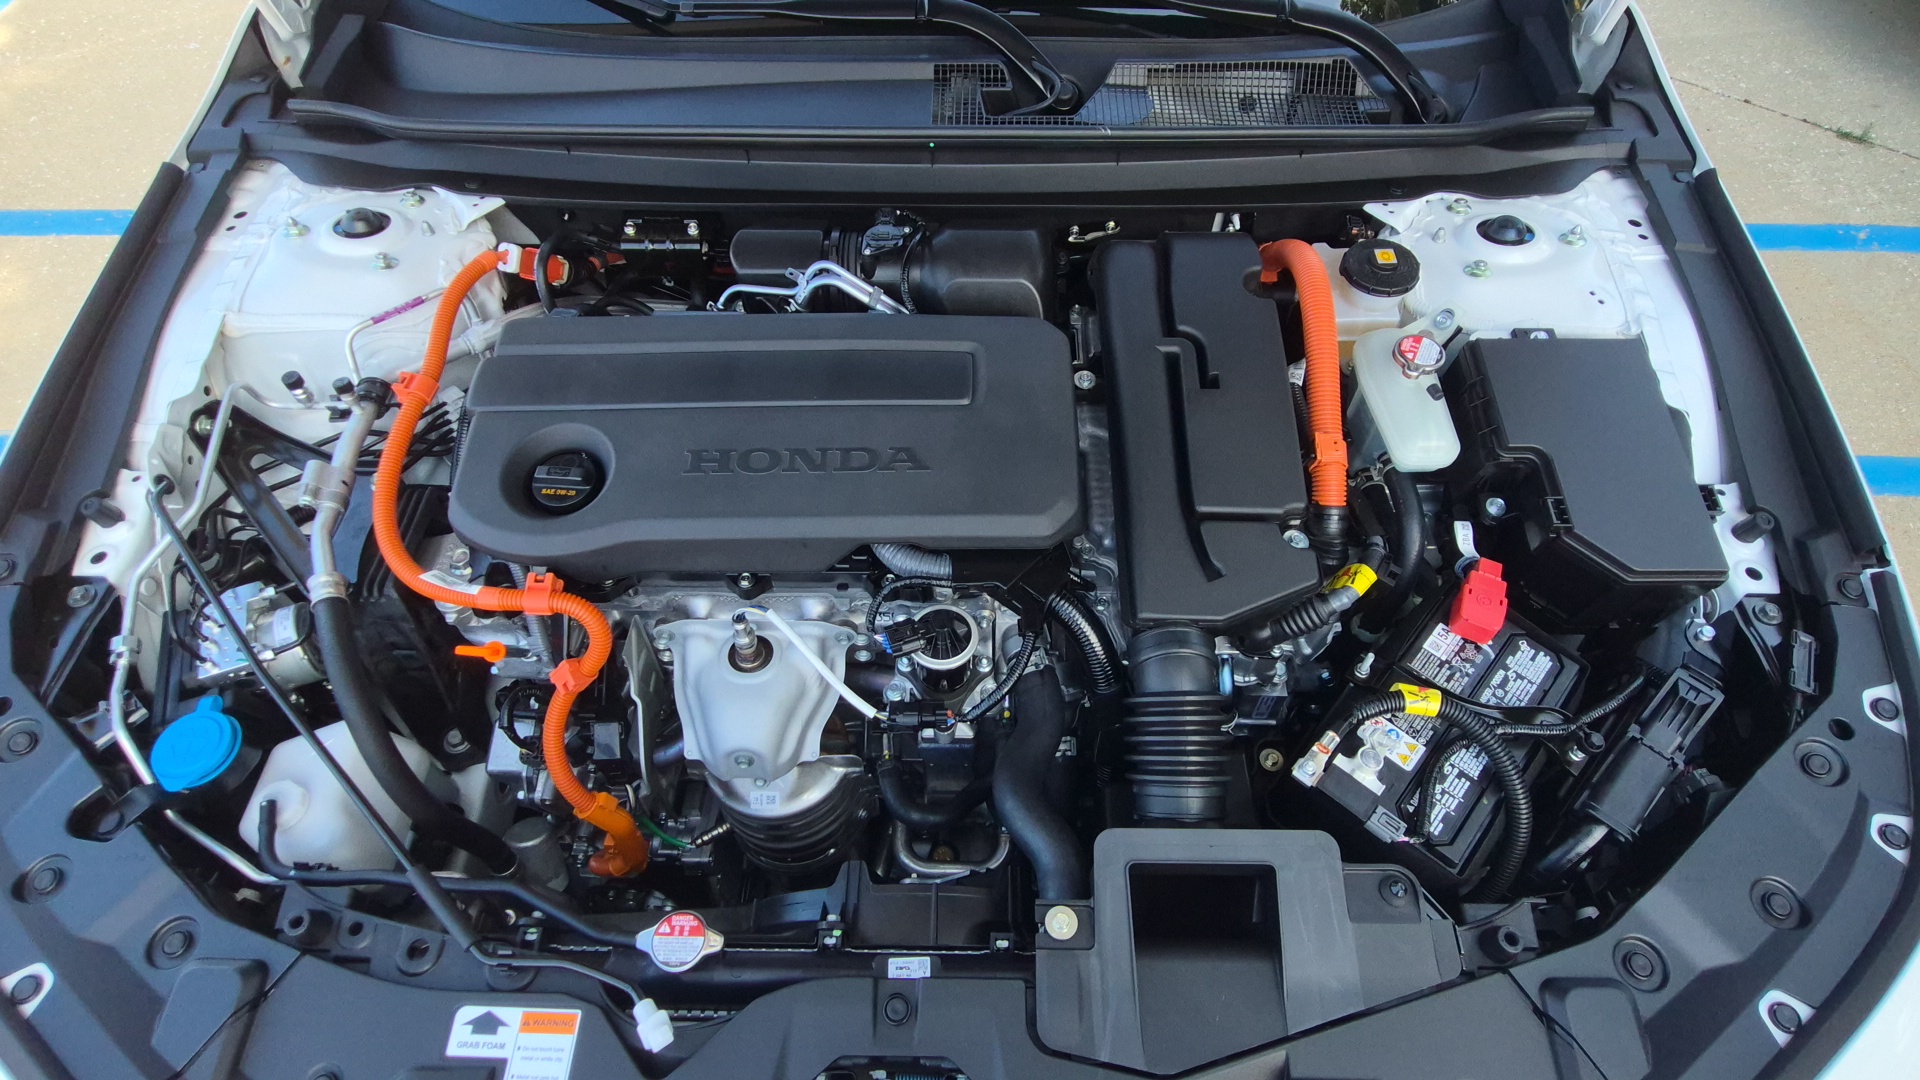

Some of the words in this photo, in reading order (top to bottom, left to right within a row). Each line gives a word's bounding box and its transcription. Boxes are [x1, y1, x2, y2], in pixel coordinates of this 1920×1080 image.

[681, 446, 932, 475] HONDA
[533, 1019, 575, 1028] WARNING
[457, 1040, 480, 1050] GRAB
[481, 1041, 506, 1051] FOAM
